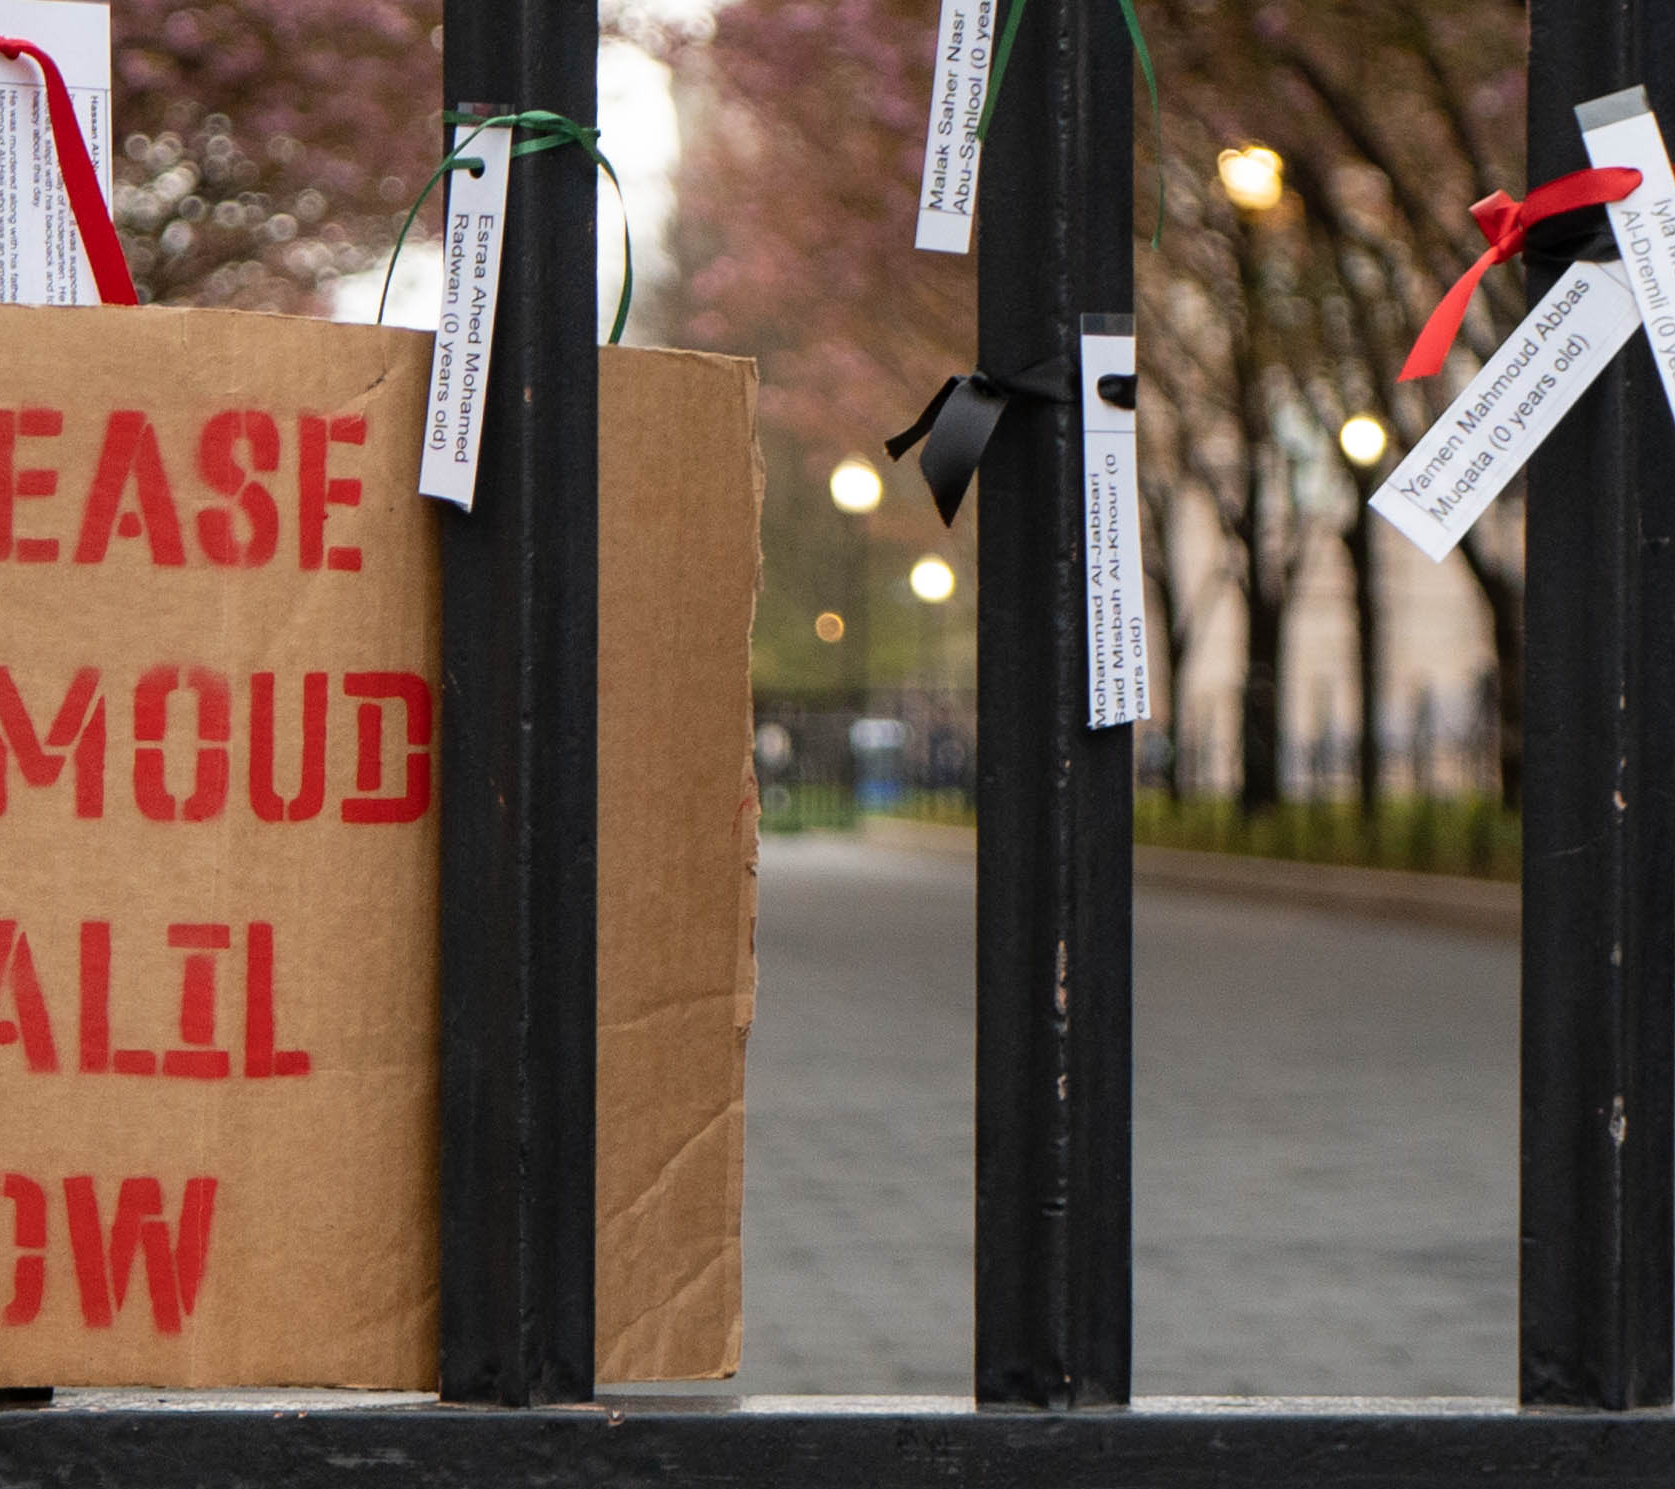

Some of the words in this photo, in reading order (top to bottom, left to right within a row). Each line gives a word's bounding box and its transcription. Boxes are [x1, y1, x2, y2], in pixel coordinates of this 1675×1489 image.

[943, 7, 968, 63] Nasr
[967, 43, 992, 70] (0
[935, 69, 962, 136] Saher
[926, 144, 951, 212] Malak
[450, 214, 470, 304] Radwan
[474, 214, 494, 277] Esraa
[442, 313, 459, 334] (0
[467, 288, 487, 345] Ahed
[435, 342, 453, 402] years
[1400, 432, 1465, 499] Yamen
[1454, 339, 1541, 436] Mahmoud
[1539, 277, 1592, 344] Abbas
[430, 410, 447, 451] old)
[453, 352, 482, 464] Mohamed
[1427, 452, 1495, 526] Muqata
[1489, 421, 1512, 455] (0
[1507, 375, 1557, 438] years
[1555, 333, 1592, 373] old)
